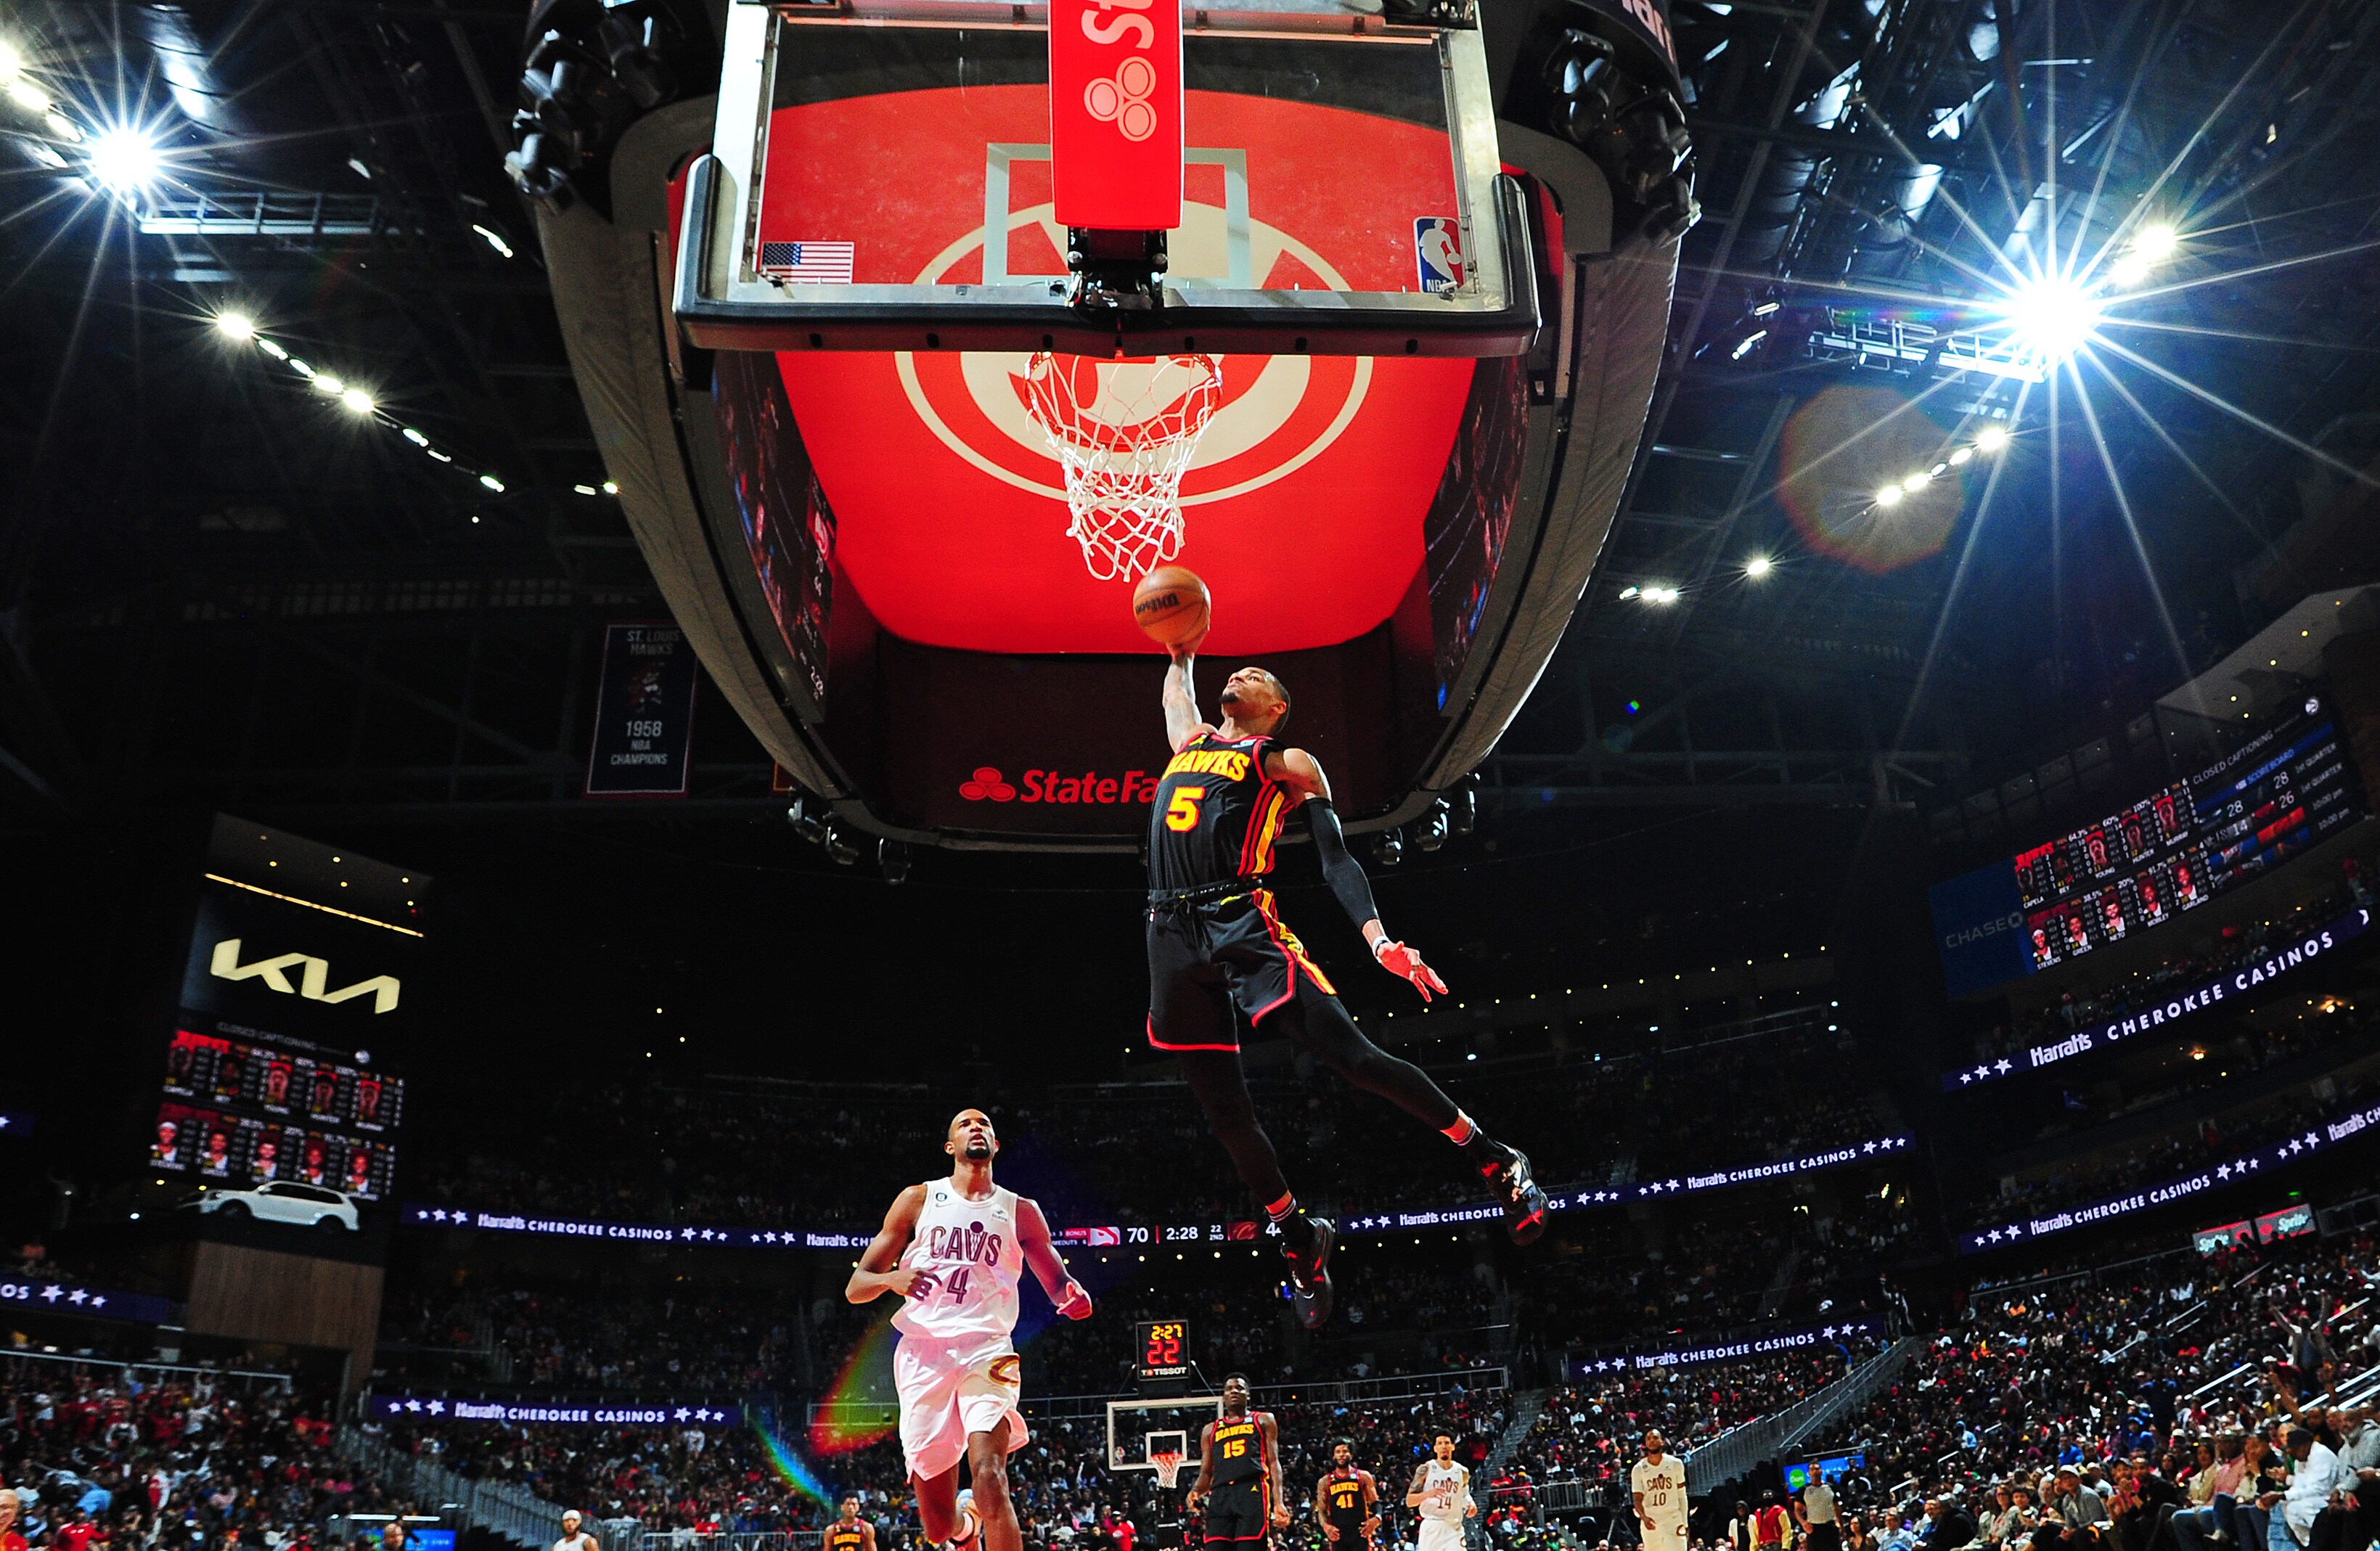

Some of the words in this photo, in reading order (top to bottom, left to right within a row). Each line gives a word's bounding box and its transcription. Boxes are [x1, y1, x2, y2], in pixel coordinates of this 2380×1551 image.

[629, 642, 674, 655] HAWKS
[626, 720, 663, 737] 1958
[630, 740, 652, 751] NBA
[610, 753, 668, 766] CHAMPIONS
[2192, 761, 2226, 785] CLOSED
[2226, 729, 2274, 766] CAPTIONING
[2305, 742, 2337, 768] QUARTER
[1163, 750, 1251, 782] HAWKS
[2247, 748, 2295, 785] SCOREBOARD
[2311, 762, 2344, 787] QUARTER
[2273, 772, 2289, 790] 28
[2132, 799, 2151, 813] 100%
[2278, 790, 2295, 809] 26
[1165, 786, 1205, 832] 5
[2226, 800, 2244, 818] 28
[2102, 815, 2119, 827] 60%
[2233, 819, 2249, 837] 14
[2199, 840, 2205, 850] 4
[2095, 866, 2116, 879] YOUNG
[2148, 861, 2168, 876] 91.7%
[2058, 885, 2070, 894] BEY
[2117, 877, 2135, 890] 20%
[2023, 896, 2045, 909] CAPELA
[2181, 893, 2210, 912] GARLAND
[2147, 912, 2170, 928] MOBLEY
[1946, 917, 2008, 949] CHASE
[2109, 930, 2127, 944] NETO
[2072, 944, 2093, 957] GREEN
[2037, 956, 2062, 971] STEVENS
[2030, 1032, 2093, 1067] Harrah's
[2106, 983, 2224, 1041] CHEROKEE
[2236, 931, 2334, 991] CASINOS
[1687, 1174, 1727, 1190] Harrah's
[1729, 1161, 1795, 1182] CHEROKEE
[1799, 1148, 1857, 1170] CASINOS
[2031, 1213, 2074, 1236] Harrah's
[2074, 1195, 2146, 1224] CHEROKEE
[2150, 1174, 2211, 1203] CASINOS
[1210, 1224, 1222, 1233] 22
[1399, 1213, 1439, 1227] Harrah's
[2278, 1213, 2309, 1233] Sprite
[528, 1220, 603, 1236] CHEROKEE
[608, 1226, 673, 1240] CASINOS
[1126, 1227, 1149, 1243] 70
[1166, 1227, 1199, 1240] 2:28
[1209, 1233, 1224, 1242] 2ND
[806, 1233, 849, 1248] Harrah's
[930, 1225, 1002, 1267] CAVS
[946, 1267, 970, 1304] 4
[1151, 1325, 1182, 1341] 2:27
[1146, 1339, 1179, 1365] 22
[1680, 1343, 1750, 1364] CHEROKEE
[1754, 1333, 1815, 1352] CASINOS
[1154, 1366, 1187, 1376] TISSOT
[507, 1407, 589, 1423] CHEROKEE
[594, 1409, 666, 1423] CASINOS
[1214, 1424, 1254, 1442] HAWKS
[1223, 1439, 1246, 1460] 15
[1329, 1481, 1359, 1496] HAWKS
[1432, 1477, 1460, 1494] CAVS
[1646, 1473, 1672, 1491] CAVS
[1336, 1492, 1354, 1509] 41
[1652, 1492, 1667, 1507] 10
